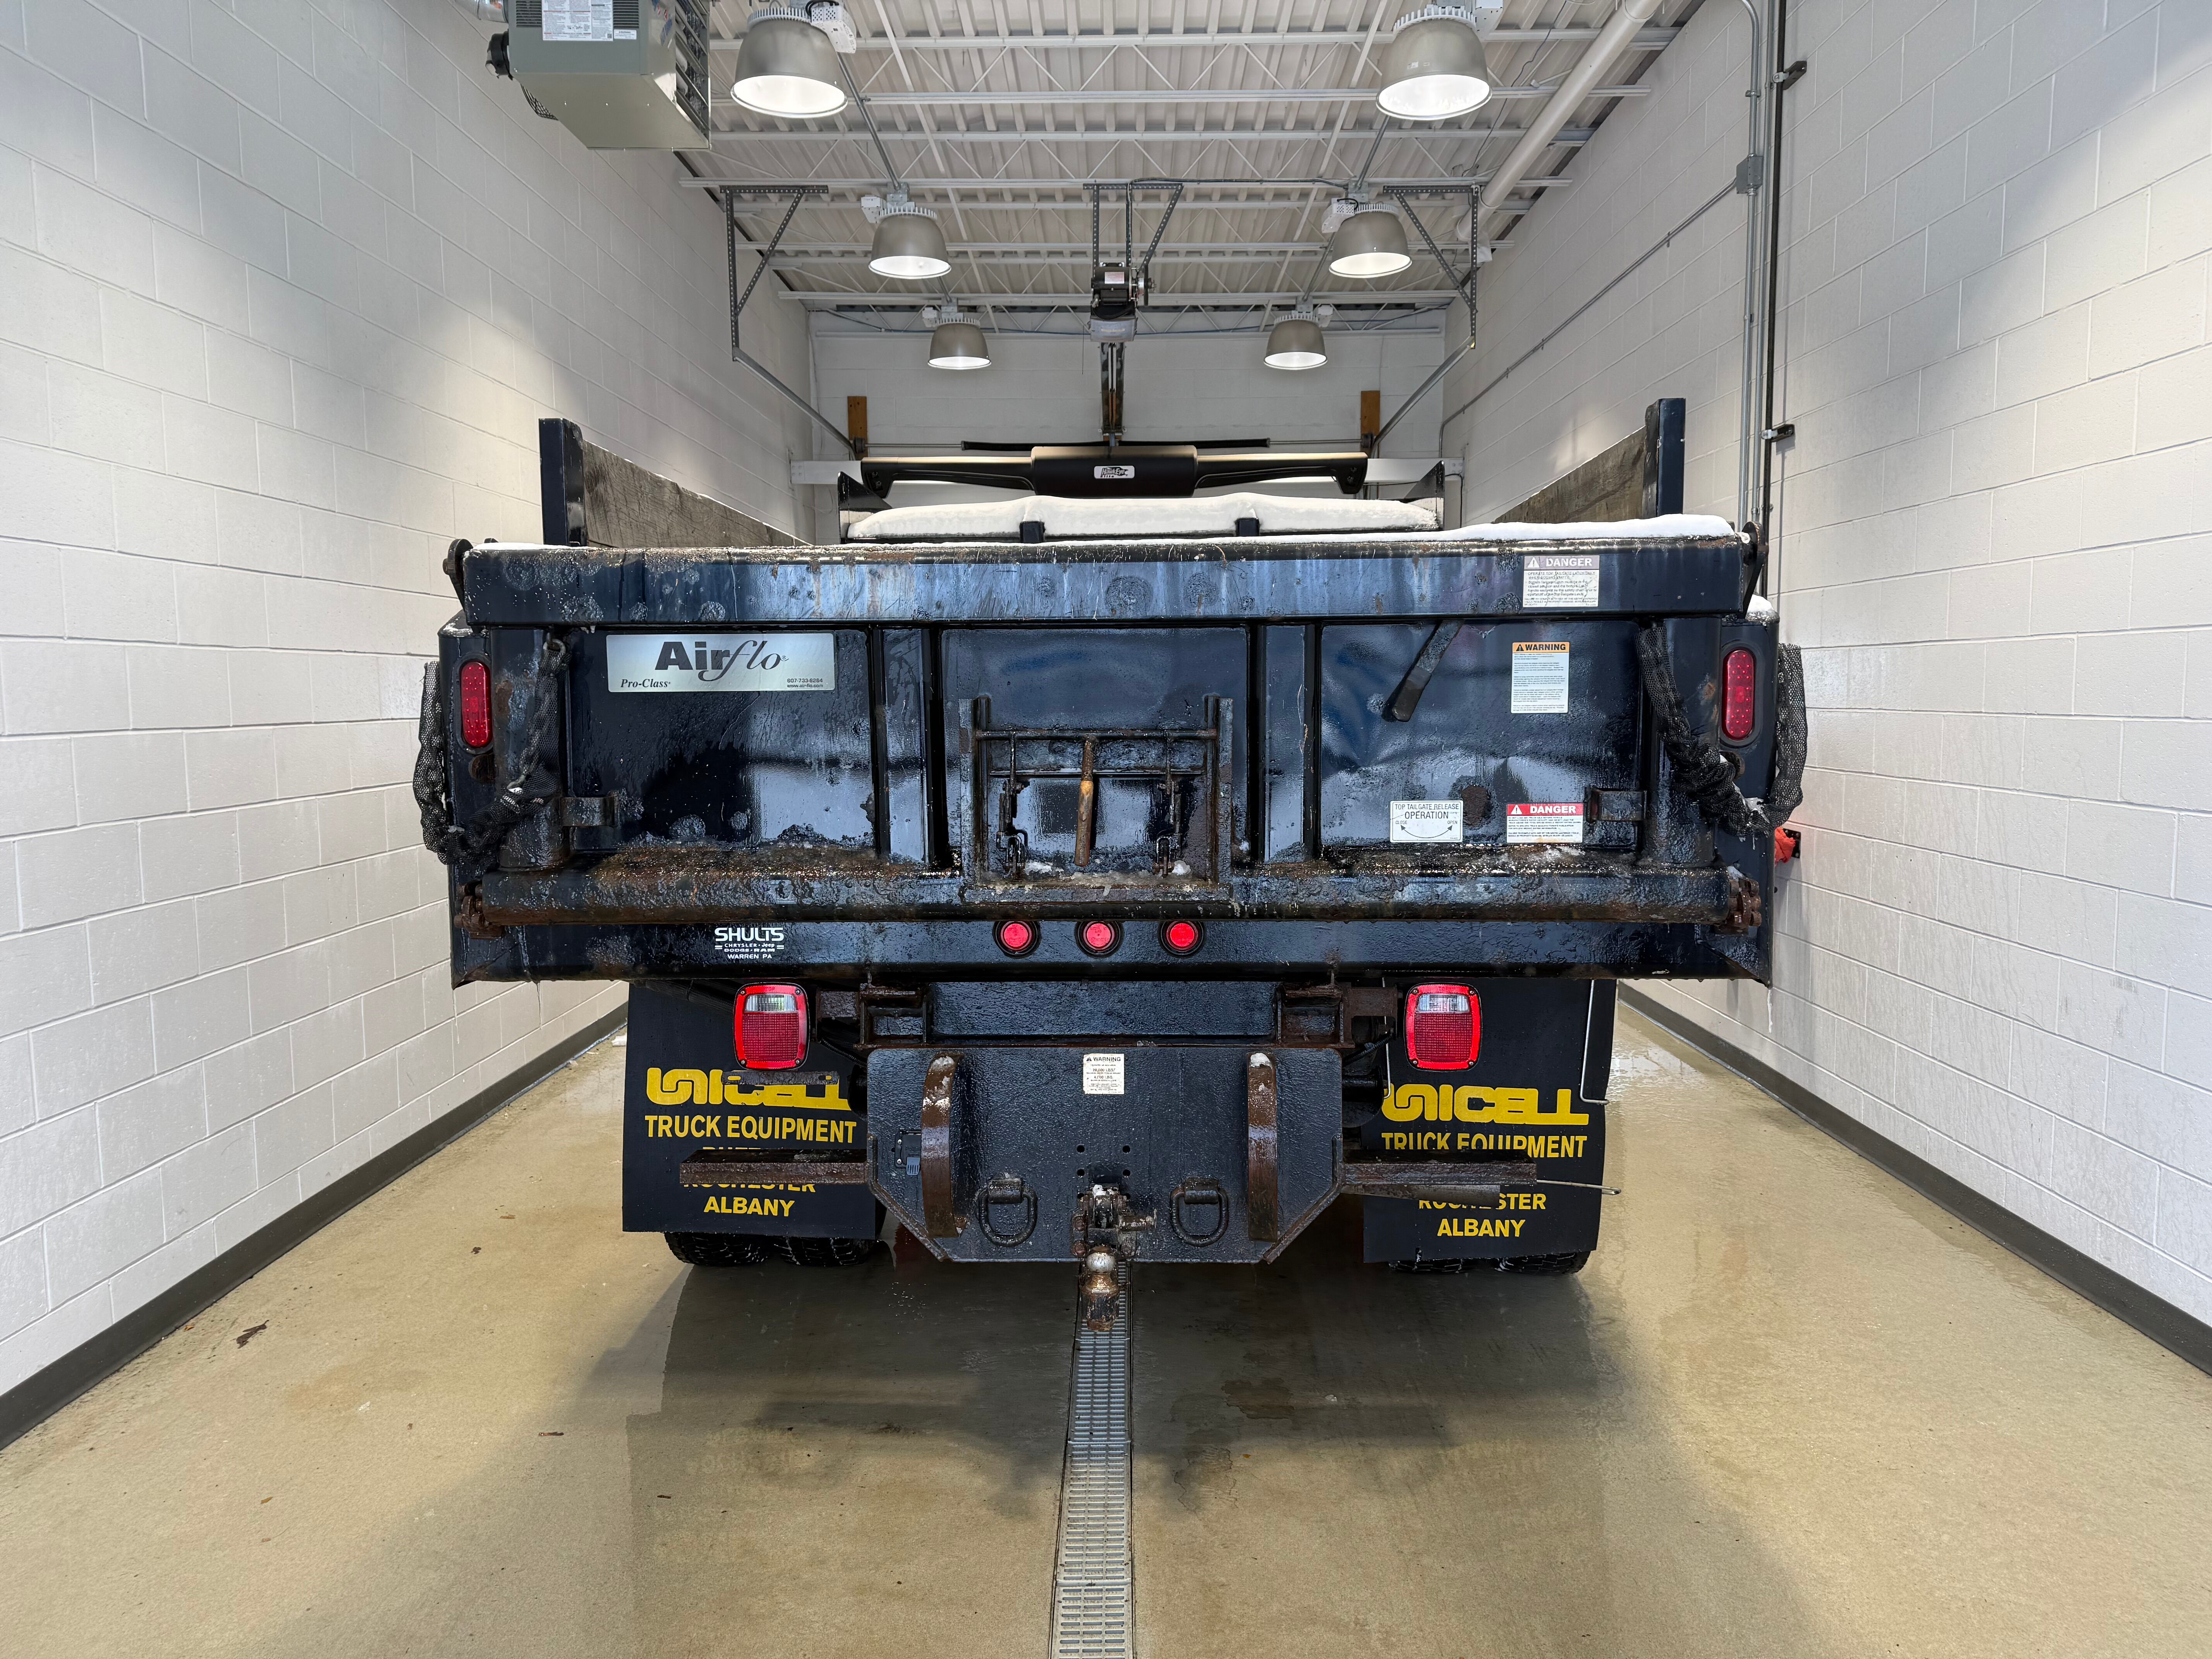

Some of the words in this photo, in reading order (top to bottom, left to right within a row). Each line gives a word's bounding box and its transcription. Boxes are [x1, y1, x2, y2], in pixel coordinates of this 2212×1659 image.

[1546, 557, 1592, 567] DANGER
[655, 640, 789, 682] Airflo
[620, 679, 668, 688] Pro-Class
[1530, 805, 1576, 814] DANGER
[714, 927, 784, 941] SHULTS
[644, 1115, 721, 1138] TRUCK
[728, 1116, 857, 1143] EQUIPMENT
[1381, 1132, 1451, 1149] TRUCK
[704, 1197, 795, 1217] ALBANY
[1437, 1218, 1526, 1237] ALBANY
